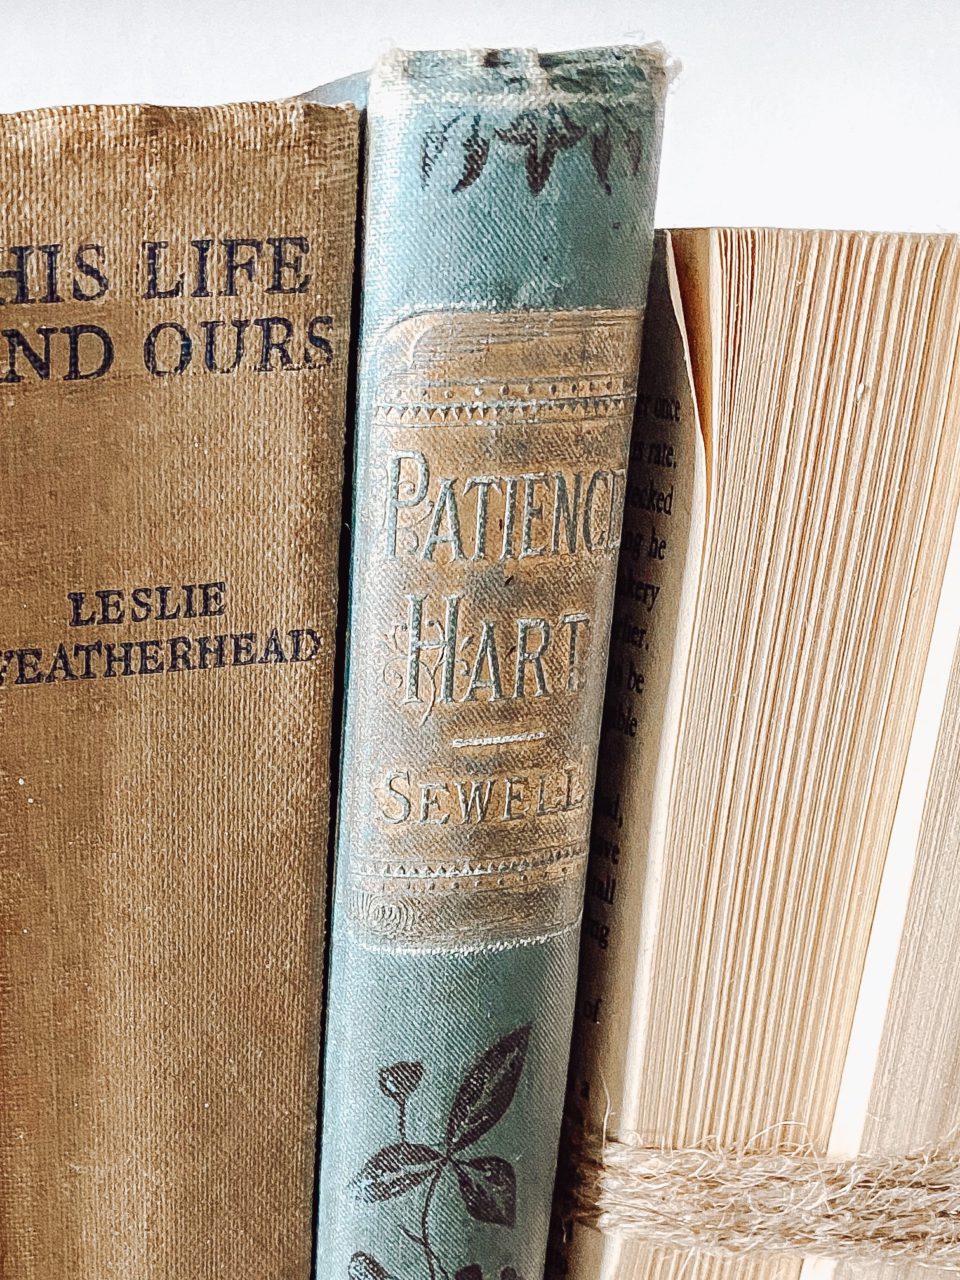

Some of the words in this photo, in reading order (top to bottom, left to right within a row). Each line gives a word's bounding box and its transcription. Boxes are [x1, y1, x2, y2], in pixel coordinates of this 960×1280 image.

[140, 236, 312, 300] LIFE
[143, 315, 335, 378] OURS
[67, 581, 227, 627] LESLIE
[390, 594, 590, 724] HART
[379, 766, 585, 825] SEWELL
